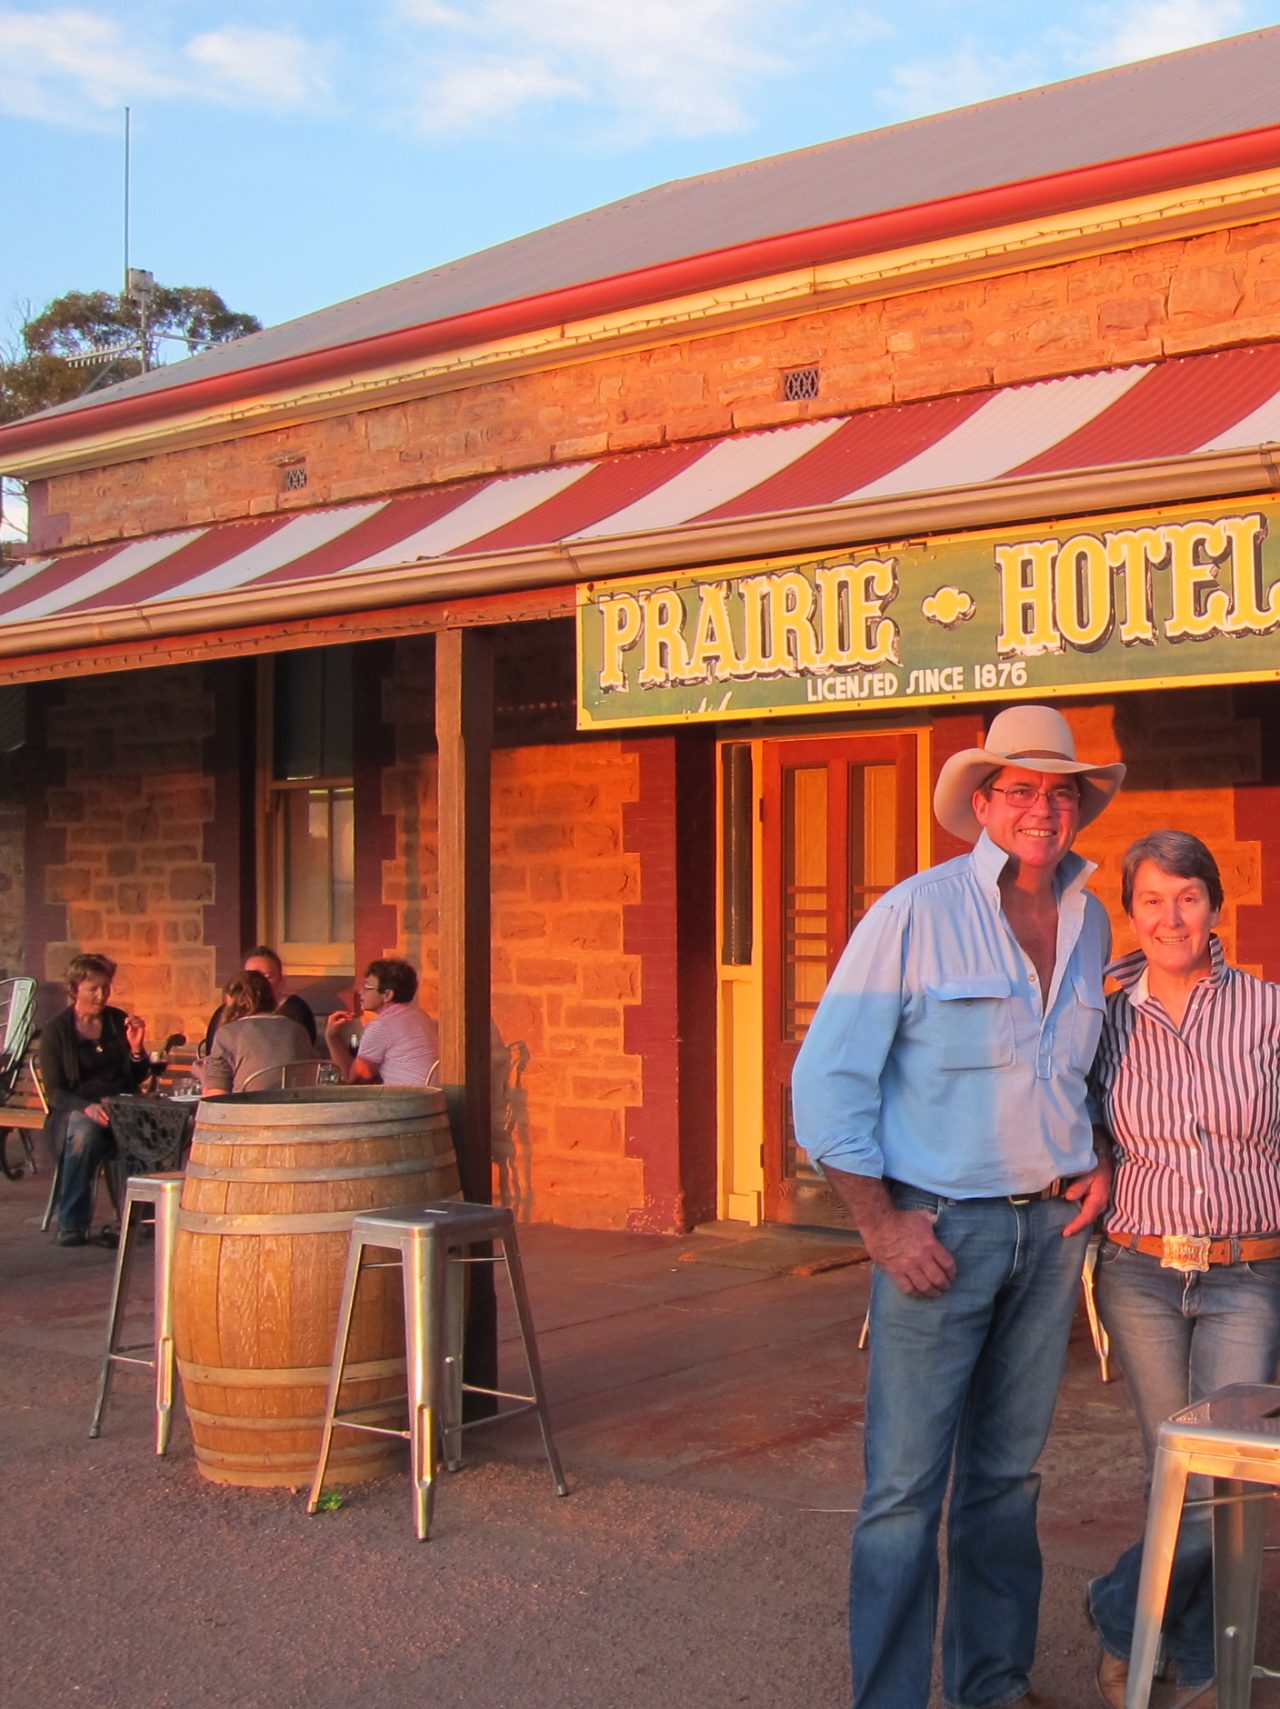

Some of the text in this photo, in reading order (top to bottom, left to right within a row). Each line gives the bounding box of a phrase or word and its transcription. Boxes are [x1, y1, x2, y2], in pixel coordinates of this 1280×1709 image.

[599, 560, 902, 693] PRAIRIE
[807, 661, 1027, 702] LICENSED SINCE 1876
